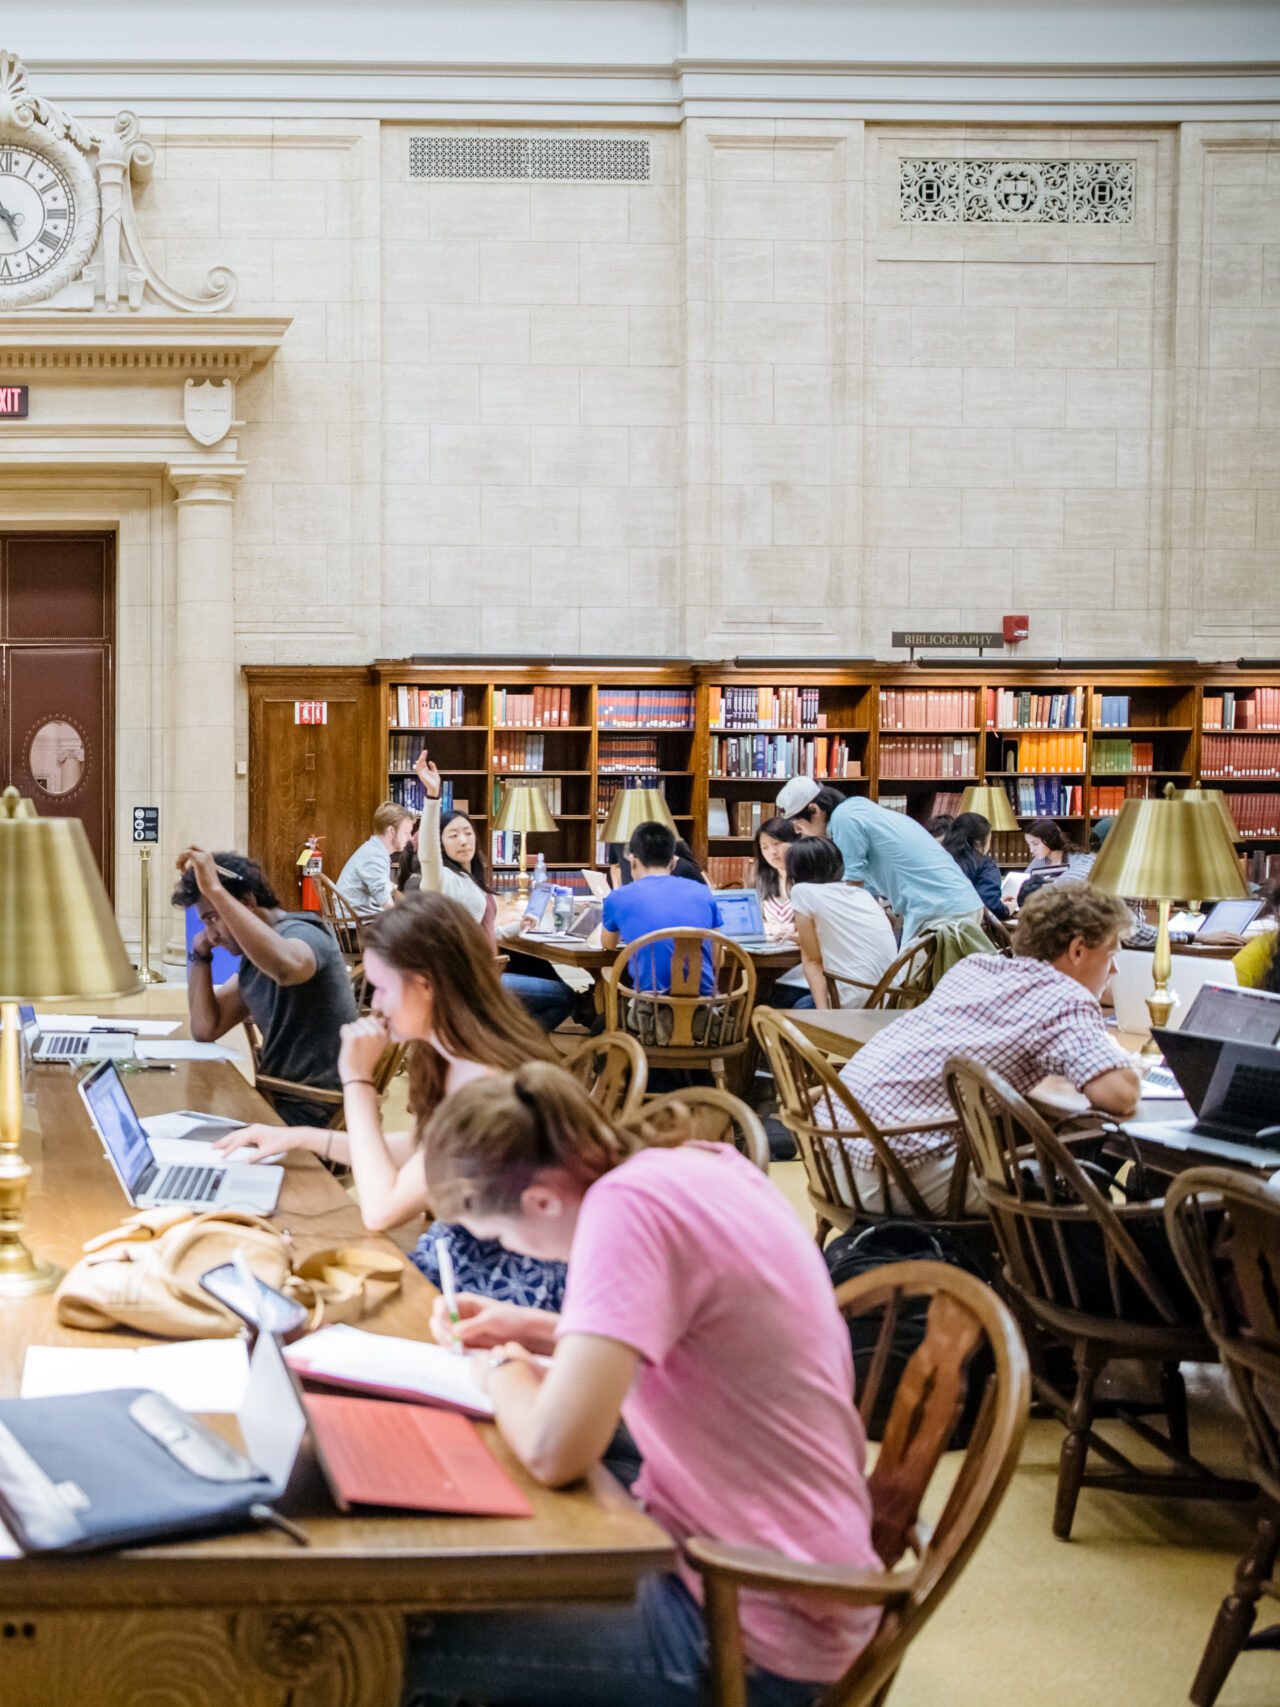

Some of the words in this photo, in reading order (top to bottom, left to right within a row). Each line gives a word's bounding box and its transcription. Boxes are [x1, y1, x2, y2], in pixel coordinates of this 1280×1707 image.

[24, 159, 36, 178] I
[39, 179, 59, 195] II
[47, 208, 67, 220] III
[26, 251, 41, 271] V
[904, 634, 993, 645] BIBLIOGRAPHY
